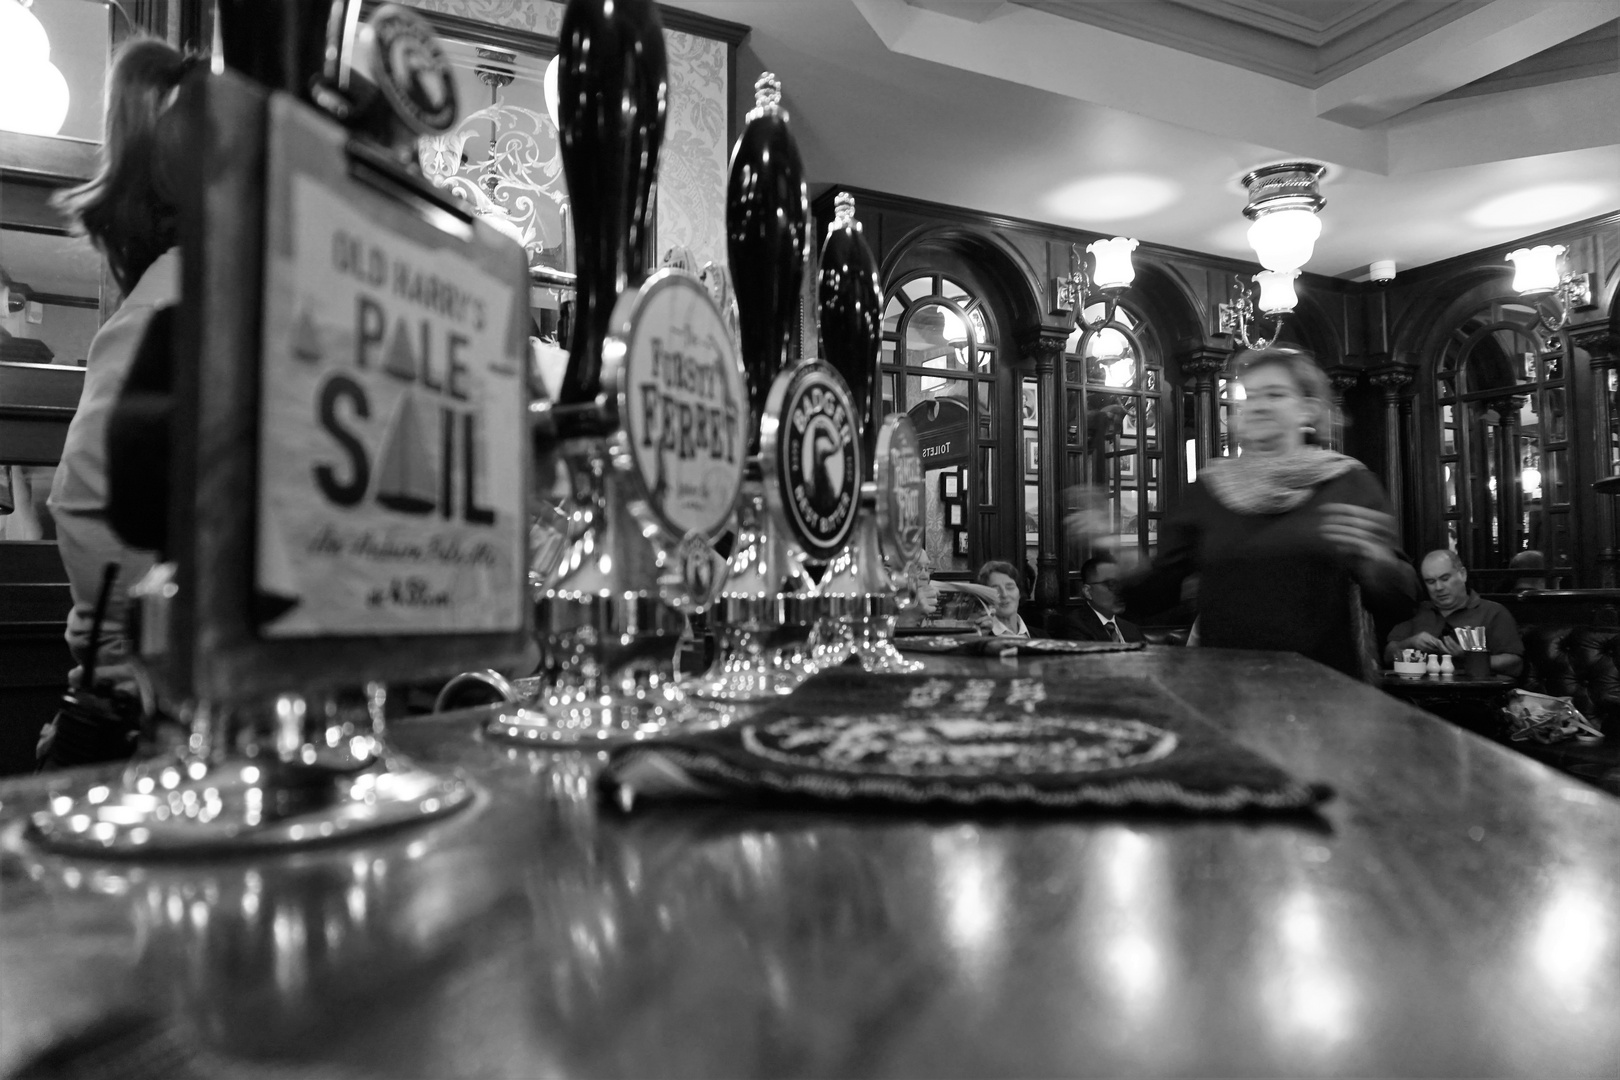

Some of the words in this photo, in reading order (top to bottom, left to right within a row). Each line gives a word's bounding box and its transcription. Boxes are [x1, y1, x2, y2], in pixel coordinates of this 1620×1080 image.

[333, 230, 388, 288] OLD
[356, 296, 469, 401] PALE
[314, 374, 495, 526] SAIL
